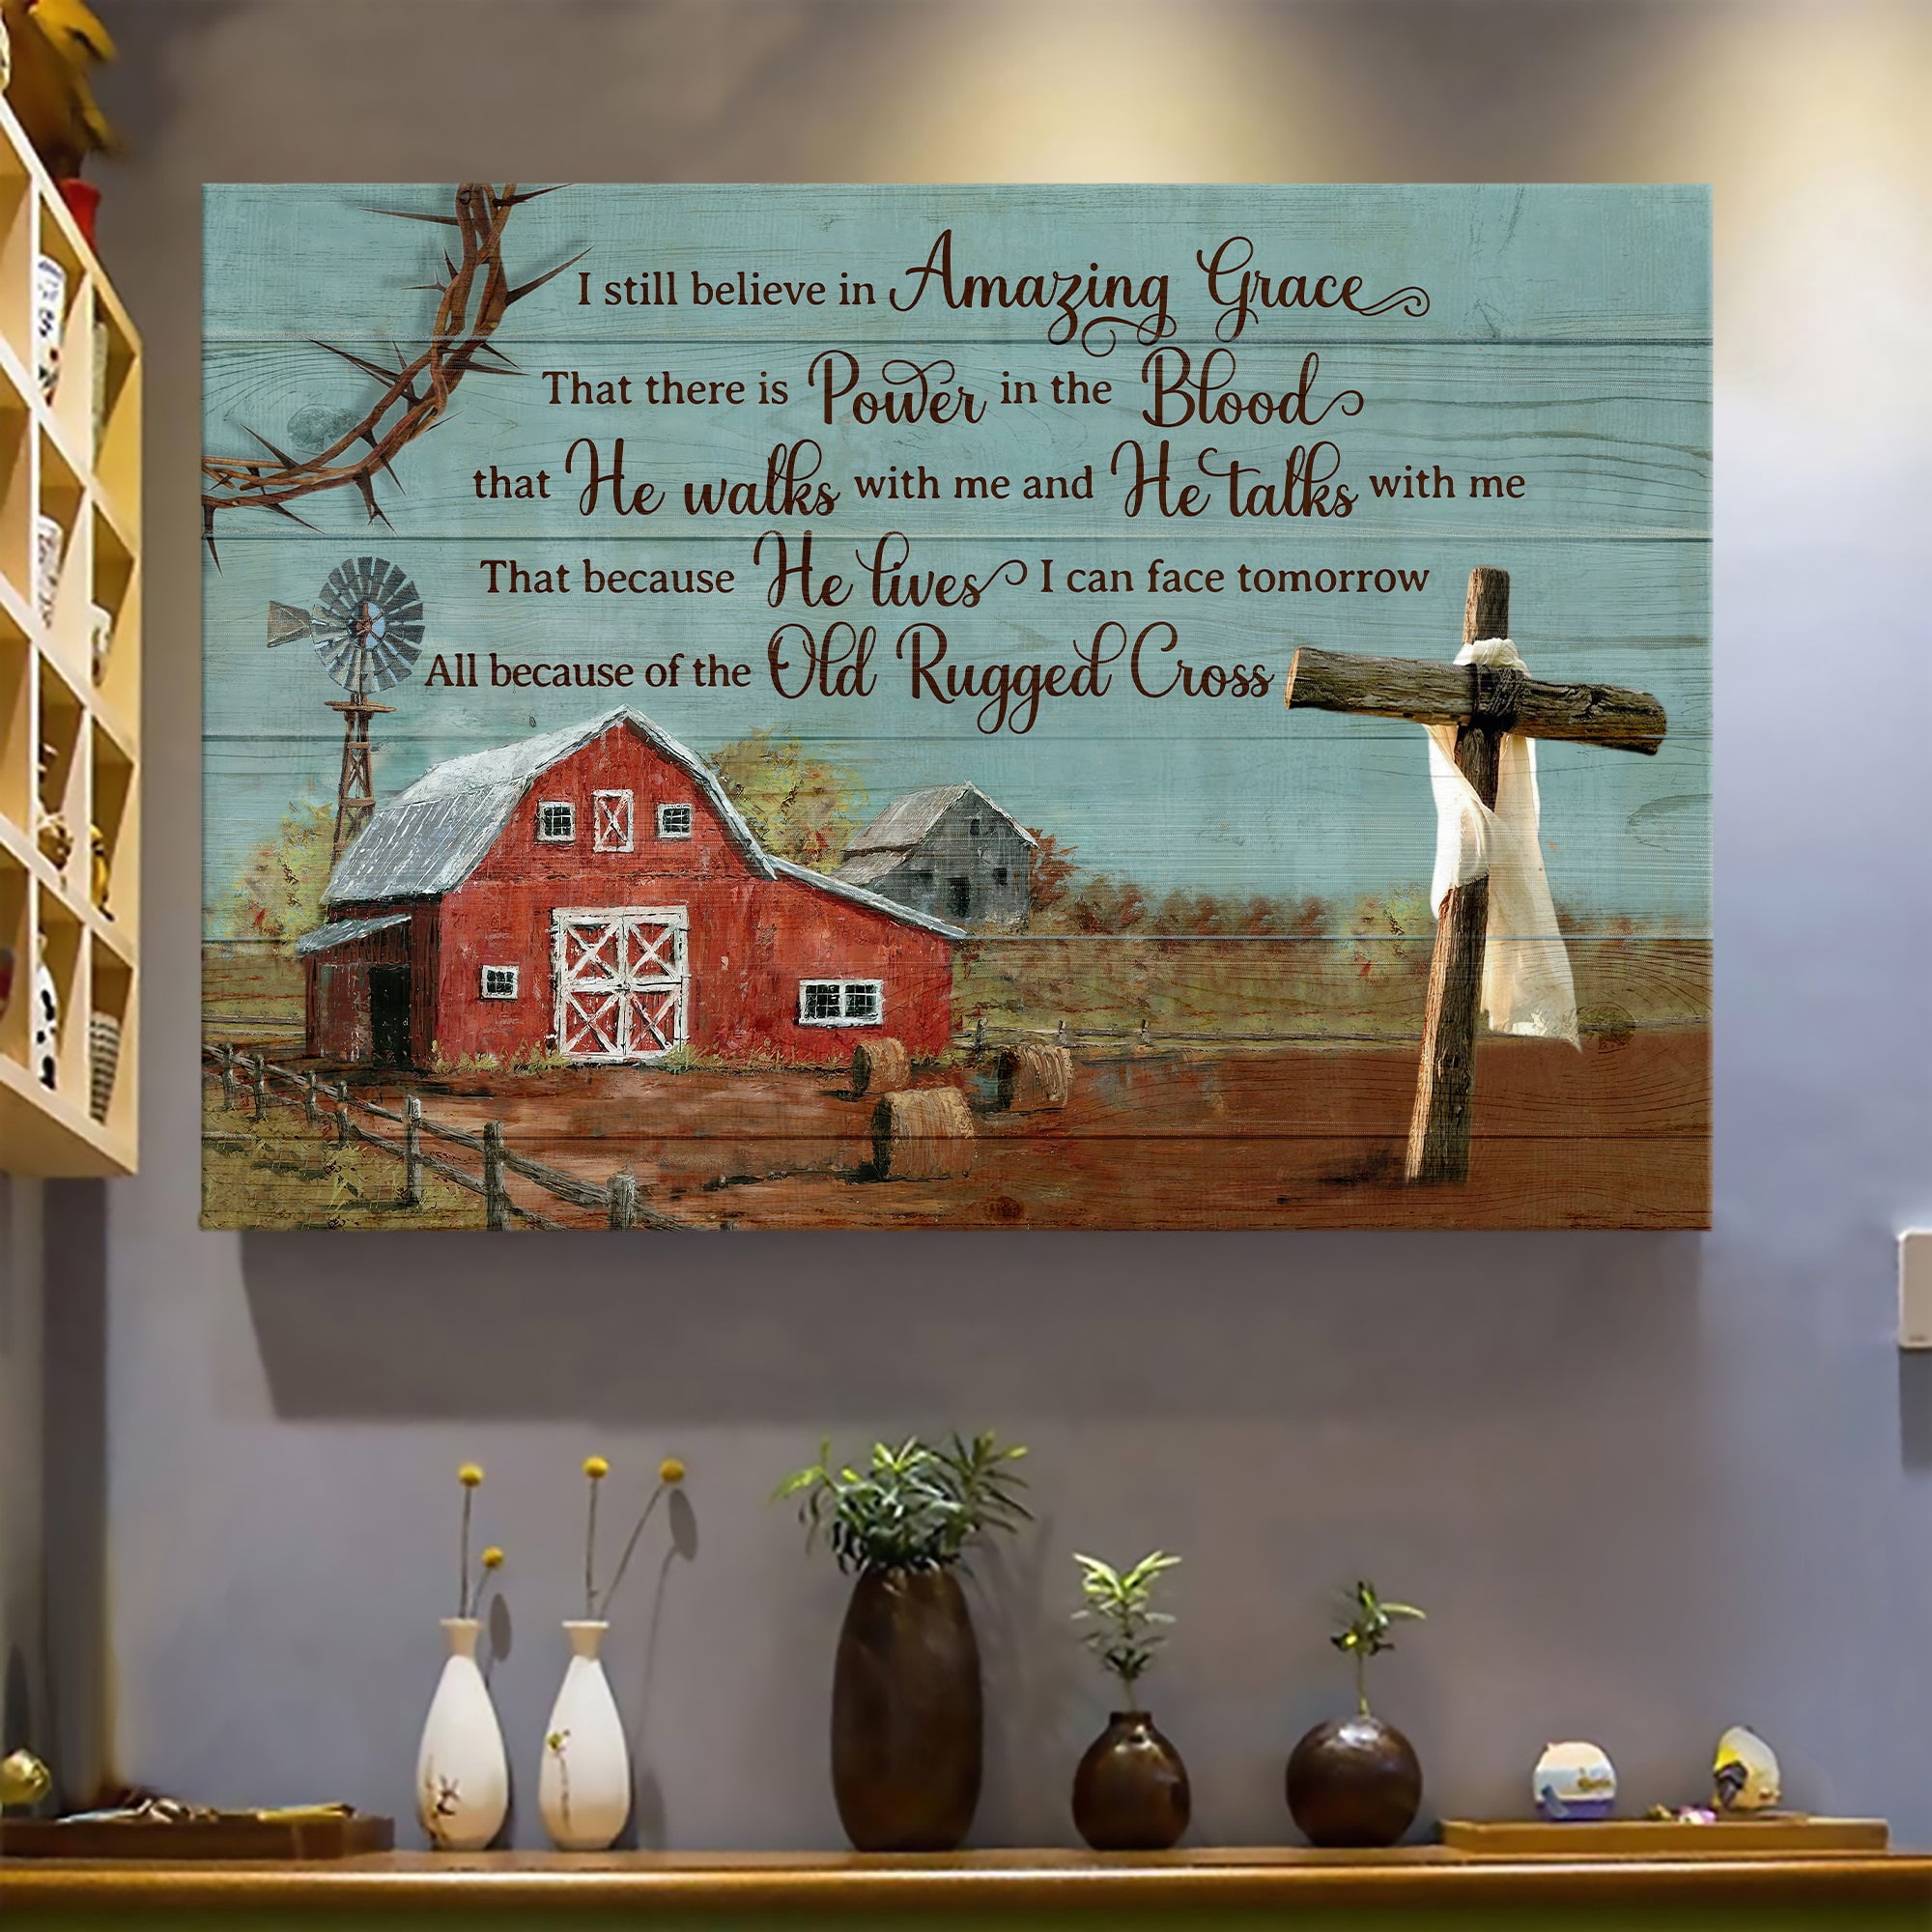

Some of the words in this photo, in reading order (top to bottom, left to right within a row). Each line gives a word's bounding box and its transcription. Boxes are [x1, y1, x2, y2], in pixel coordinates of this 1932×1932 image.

[578, 271, 591, 306] I
[604, 270, 678, 306] still
[691, 270, 826, 306] believe
[838, 271, 876, 305] in
[889, 229, 1178, 358] Amazing
[1196, 236, 1431, 343] Grace
[541, 370, 633, 405] That
[644, 370, 745, 405] there
[757, 370, 789, 405] is
[808, 349, 987, 425] Power
[1000, 370, 1038, 405] in
[1050, 370, 1113, 405] the
[1141, 346, 1365, 428] Blood
[472, 465, 552, 499] that
[564, 438, 666, 517] He
[683, 439, 841, 517] walks
[853, 465, 941, 499] with
[953, 475, 1010, 499] me
[1023, 465, 1094, 499] and
[1110, 440, 1211, 518] He
[1197, 440, 1359, 519] talks
[1369, 465, 1456, 498] with
[1468, 474, 1525, 498] me
[479, 559, 570, 594] That
[582, 558, 735, 594] because
[753, 529, 854, 609] He
[855, 530, 1028, 609] lives
[1041, 558, 1054, 593] I
[1066, 569, 1135, 593] can
[1148, 558, 1225, 593] face
[1236, 563, 1431, 593] tomorrow
[423, 652, 479, 688] All
[489, 652, 635, 688] because
[644, 652, 686, 688] of
[692, 653, 752, 688] the
[767, 620, 878, 699] Old
[895, 620, 1127, 735] Rugged
[1130, 621, 1276, 698] Cross
